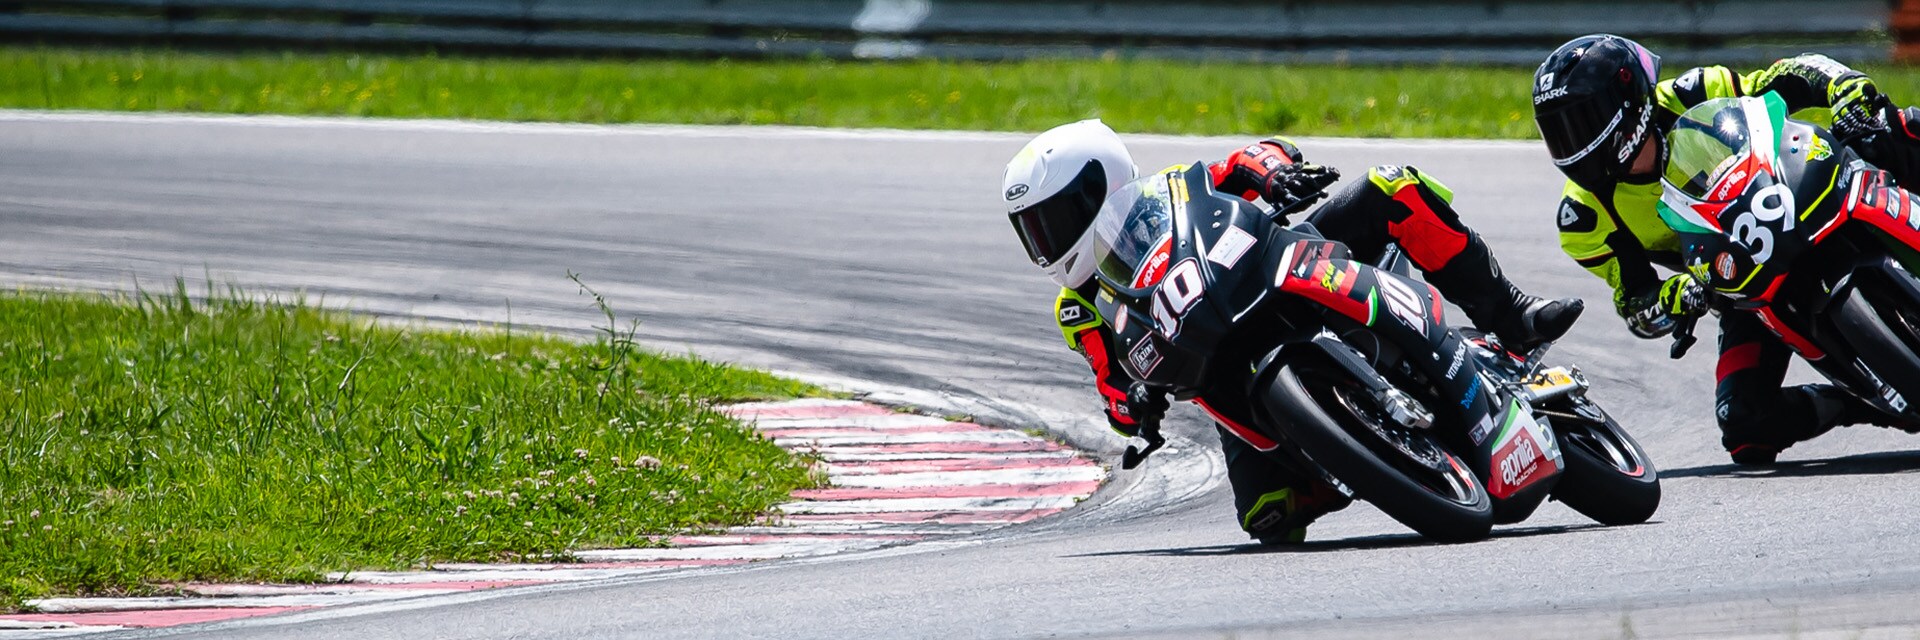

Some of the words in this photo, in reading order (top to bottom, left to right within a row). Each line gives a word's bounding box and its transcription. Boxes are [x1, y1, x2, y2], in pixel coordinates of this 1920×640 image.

[1534, 85, 1568, 105] SHARK
[1618, 96, 1653, 164] SHARK
[1007, 185, 1027, 198] HJC
[1718, 170, 1747, 201] aprilia
[1732, 182, 1796, 266] 39
[1142, 251, 1170, 287] aprilia
[1151, 258, 1205, 341] 10
[1374, 268, 1429, 339] 10
[1500, 436, 1536, 486] aprilia
[1516, 462, 1538, 486] RACING
